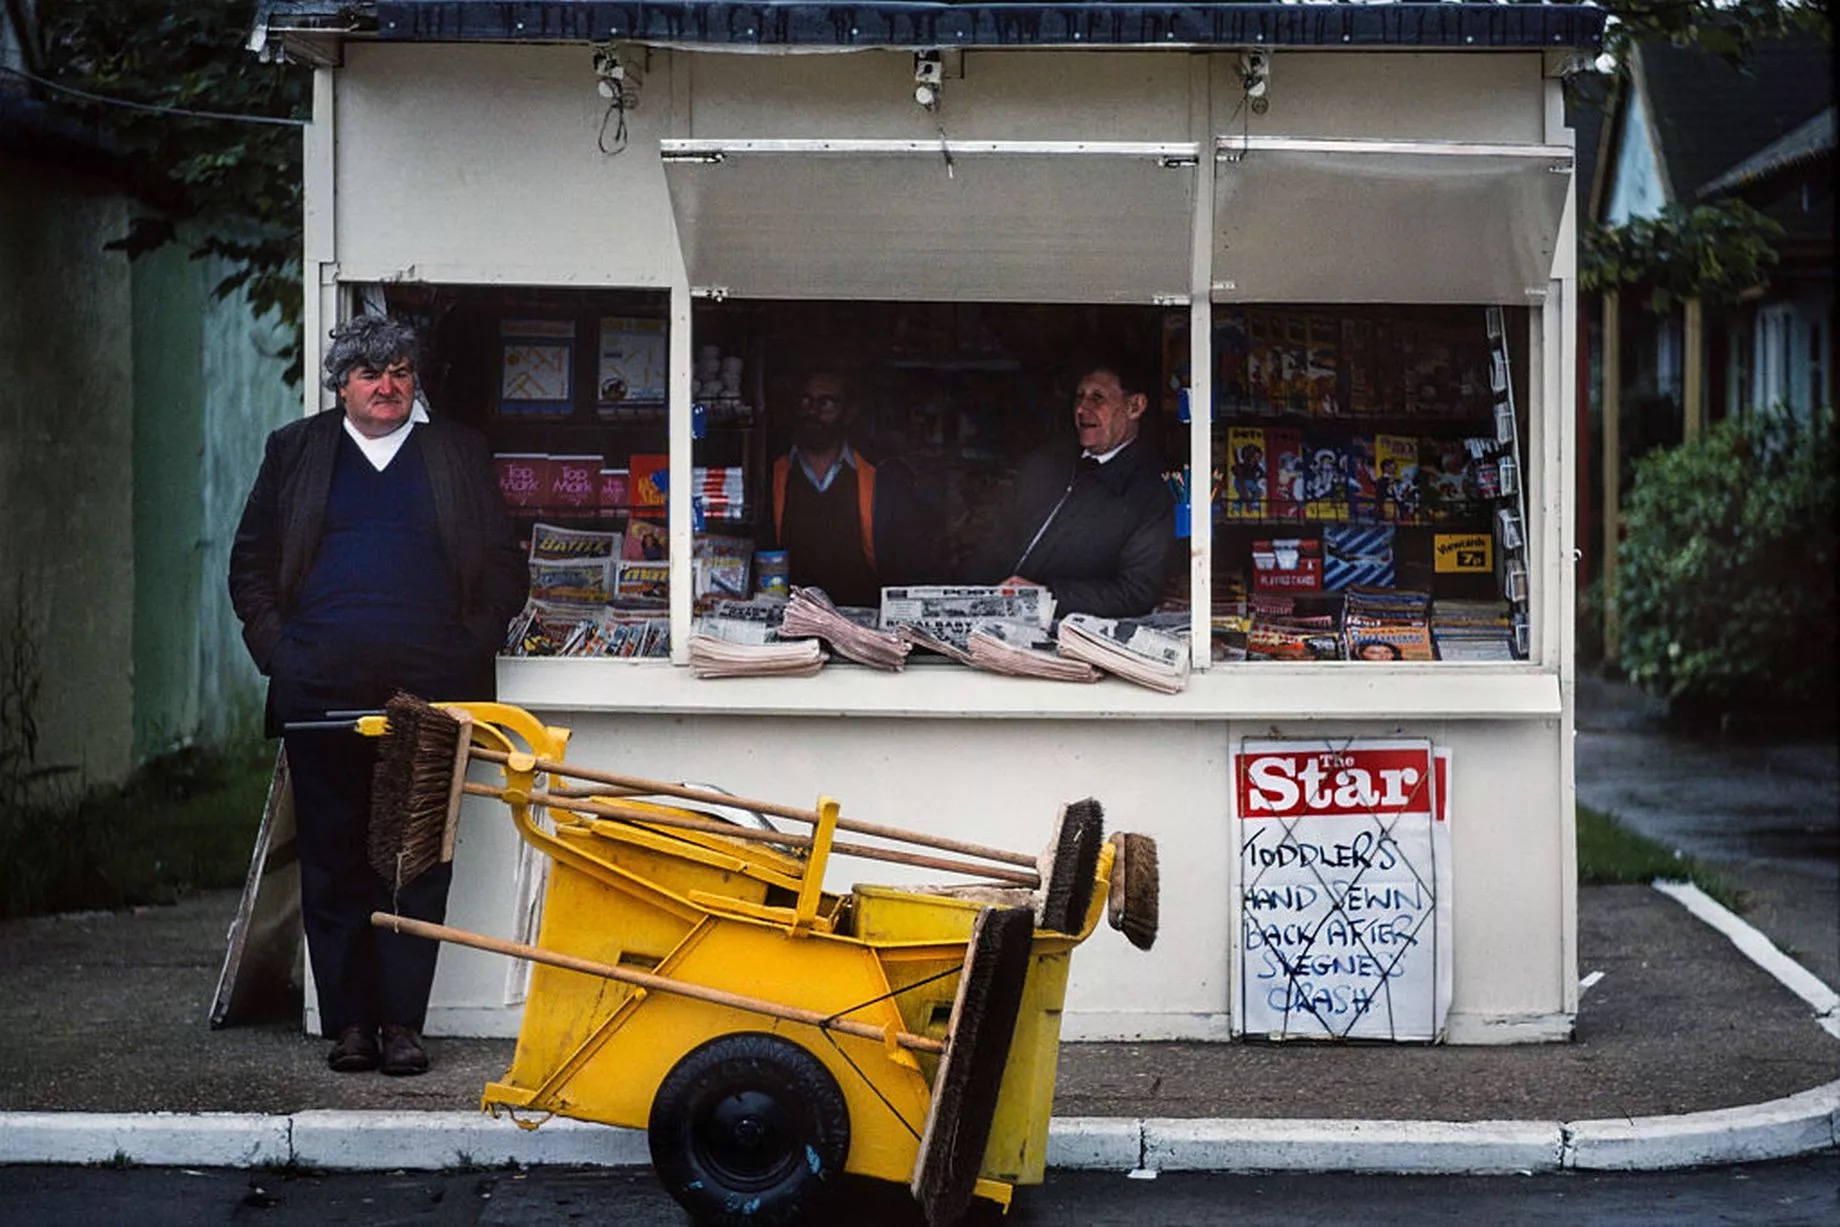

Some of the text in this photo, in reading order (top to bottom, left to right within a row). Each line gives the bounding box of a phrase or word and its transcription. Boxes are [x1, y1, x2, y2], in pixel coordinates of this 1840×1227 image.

[1319, 754, 1355, 768] The
[1249, 757, 1419, 812] Star
[1244, 880, 1422, 911] HAND SEWN
[1246, 914, 1418, 950] BACK AFTER
[1258, 949, 1406, 979] SKEGNESS
[1268, 982, 1374, 1014] CRASH
